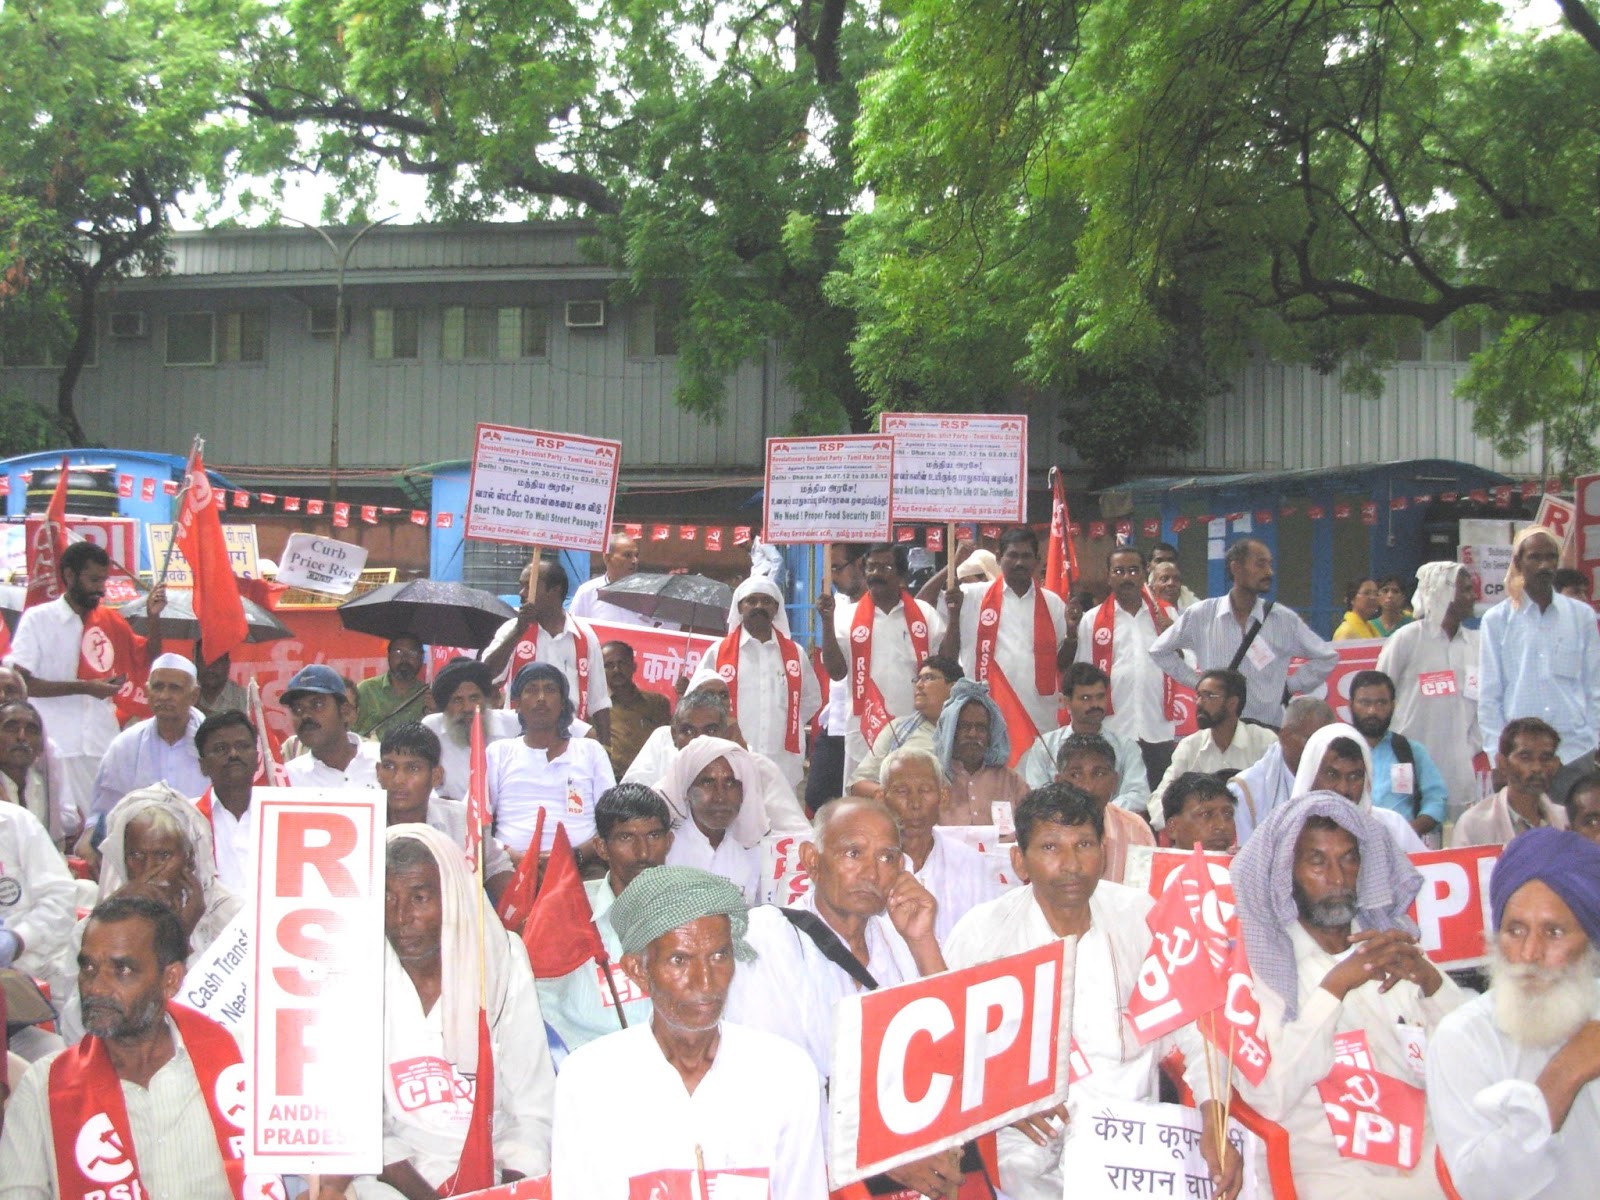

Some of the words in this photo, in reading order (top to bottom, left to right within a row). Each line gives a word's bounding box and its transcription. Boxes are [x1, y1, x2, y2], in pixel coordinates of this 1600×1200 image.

[893, 431, 925, 440] volutionary
[940, 420, 969, 430] RSP
[536, 437, 565, 450] RSP
[819, 442, 845, 451] RSP
[474, 503, 490, 515] Shut
[491, 505, 505, 516] The
[506, 507, 524, 519] Door
[524, 509, 534, 520] To
[535, 511, 550, 522] Wall
[550, 512, 571, 525] Street
[571, 516, 599, 530] Passage
[773, 511, 783, 521] We
[784, 511, 800, 520] Need
[804, 511, 824, 522] Proper
[824, 510, 841, 520] Food
[842, 510, 869, 523] Security
[870, 510, 882, 520] Bill
[311, 540, 346, 560] Curb
[290, 552, 326, 571] Price
[328, 562, 356, 580] Rise
[1484, 583, 1505, 595] CP
[856, 656, 866, 700] RSP
[1421, 680, 1456, 696] CPI
[792, 690, 800, 735] RSP
[1413, 856, 1498, 952] PI
[187, 971, 225, 1009] Cash
[876, 959, 1057, 1136] CPI
[1092, 1107, 1146, 1145] कैश
[1104, 1164, 1176, 1196] राशन
